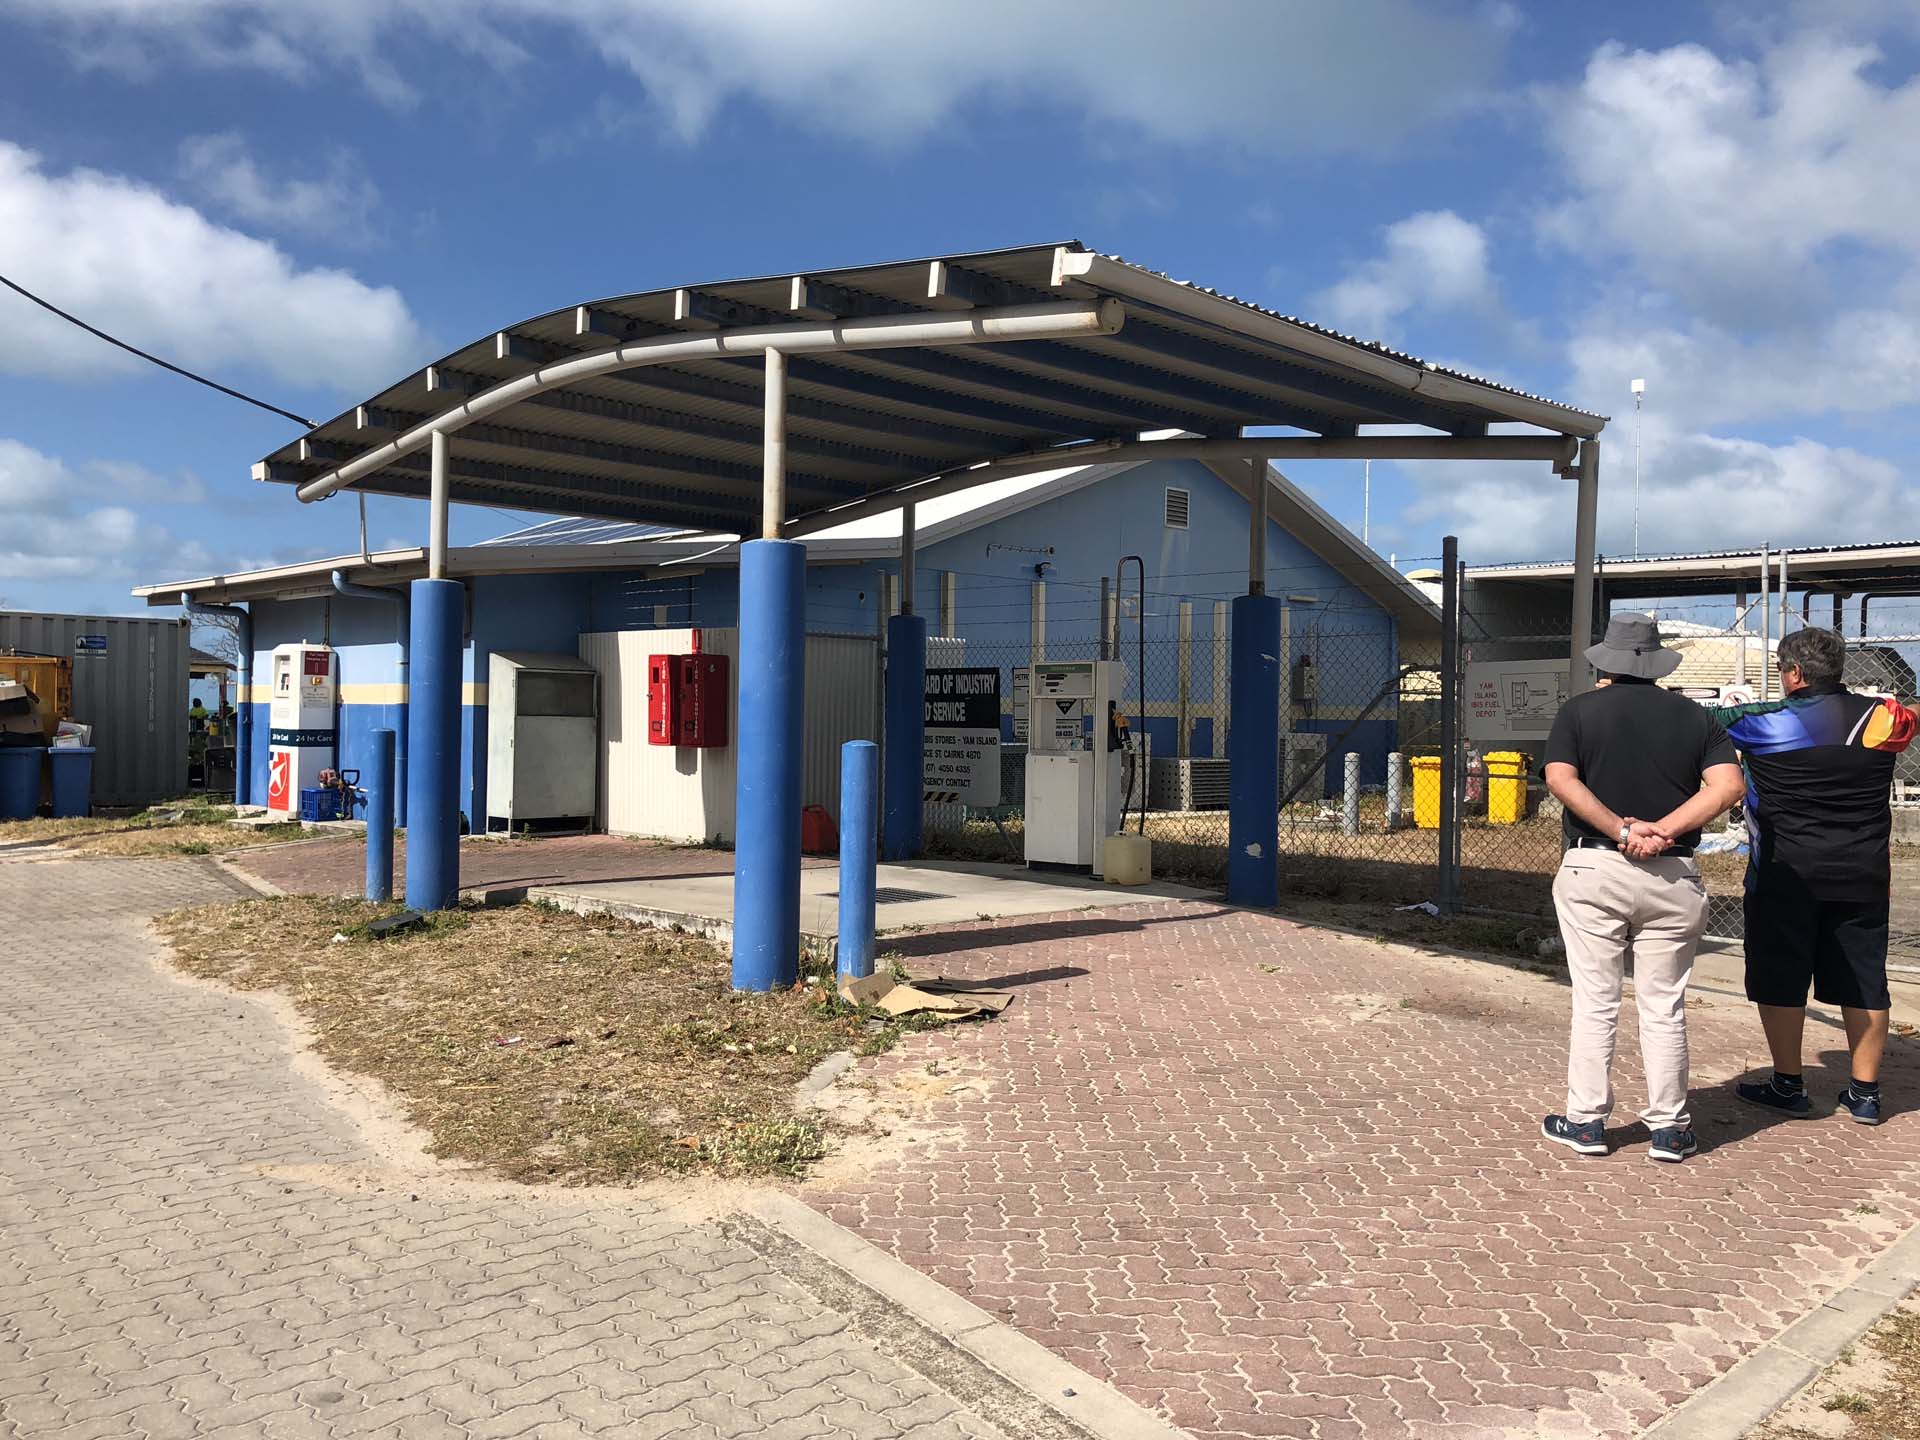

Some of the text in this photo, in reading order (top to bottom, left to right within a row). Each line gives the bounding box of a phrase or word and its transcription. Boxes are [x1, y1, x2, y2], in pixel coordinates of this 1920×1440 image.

[925, 674, 996, 695] ARD OF INDUSTRY
[1474, 691, 1498, 699] ISLAND
[932, 701, 966, 721] SERVICE
[1475, 710, 1497, 718] DEPOT
[295, 734, 305, 742] 24
[935, 735, 957, 745] STORES
[962, 736, 975, 745] YAM
[976, 736, 998, 746] ISLAND
[943, 750, 965, 759] CAIRNS
[966, 750, 982, 760] 4870
[945, 778, 971, 789] CONTACT
